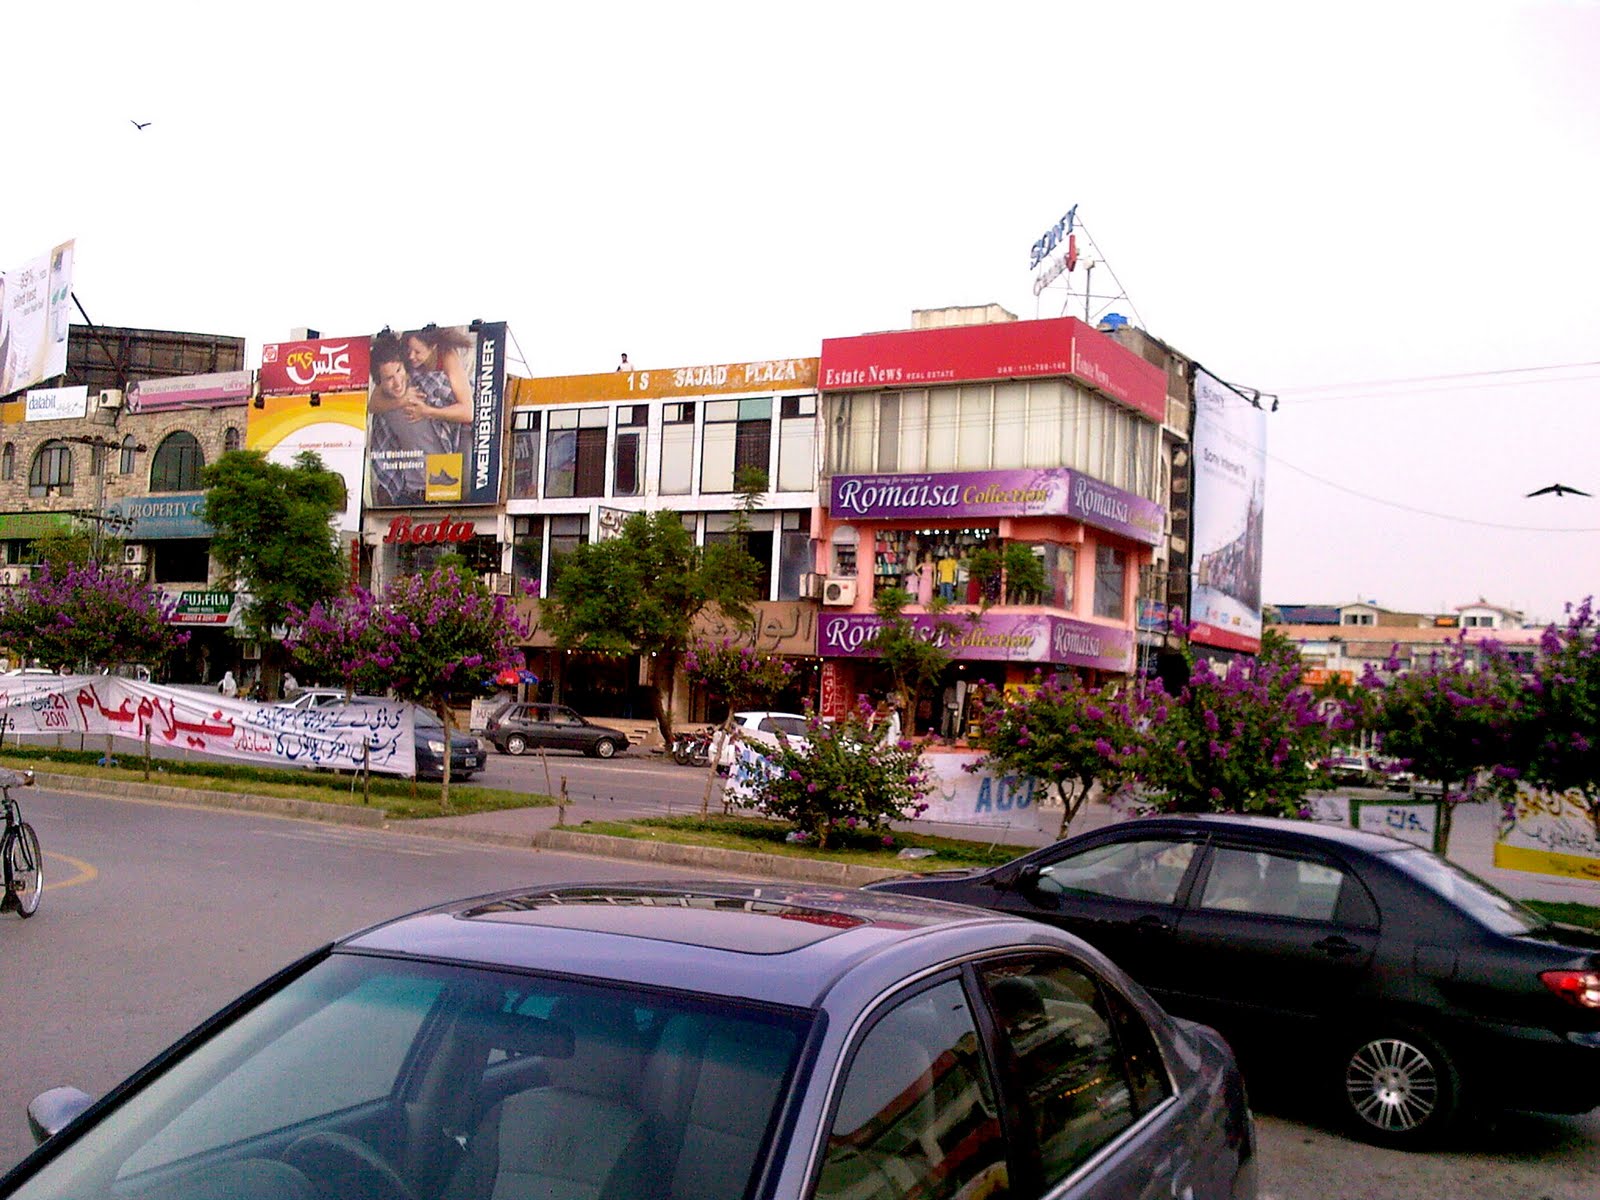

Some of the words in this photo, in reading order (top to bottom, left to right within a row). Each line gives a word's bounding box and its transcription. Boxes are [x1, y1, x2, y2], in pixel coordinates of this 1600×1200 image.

[675, 366, 727, 388] SAJAID
[744, 361, 796, 383] PLAZA
[825, 368, 866, 385] Estate
[868, 364, 903, 381] News
[476, 339, 495, 490] WEINBRENNER
[128, 502, 188, 518] PROPERTY
[839, 477, 960, 515] Romaisa
[963, 484, 1048, 505] Collection
[1075, 478, 1129, 523] Romaisa
[383, 514, 477, 545] Bata
[42, 711, 69, 727] 2011
